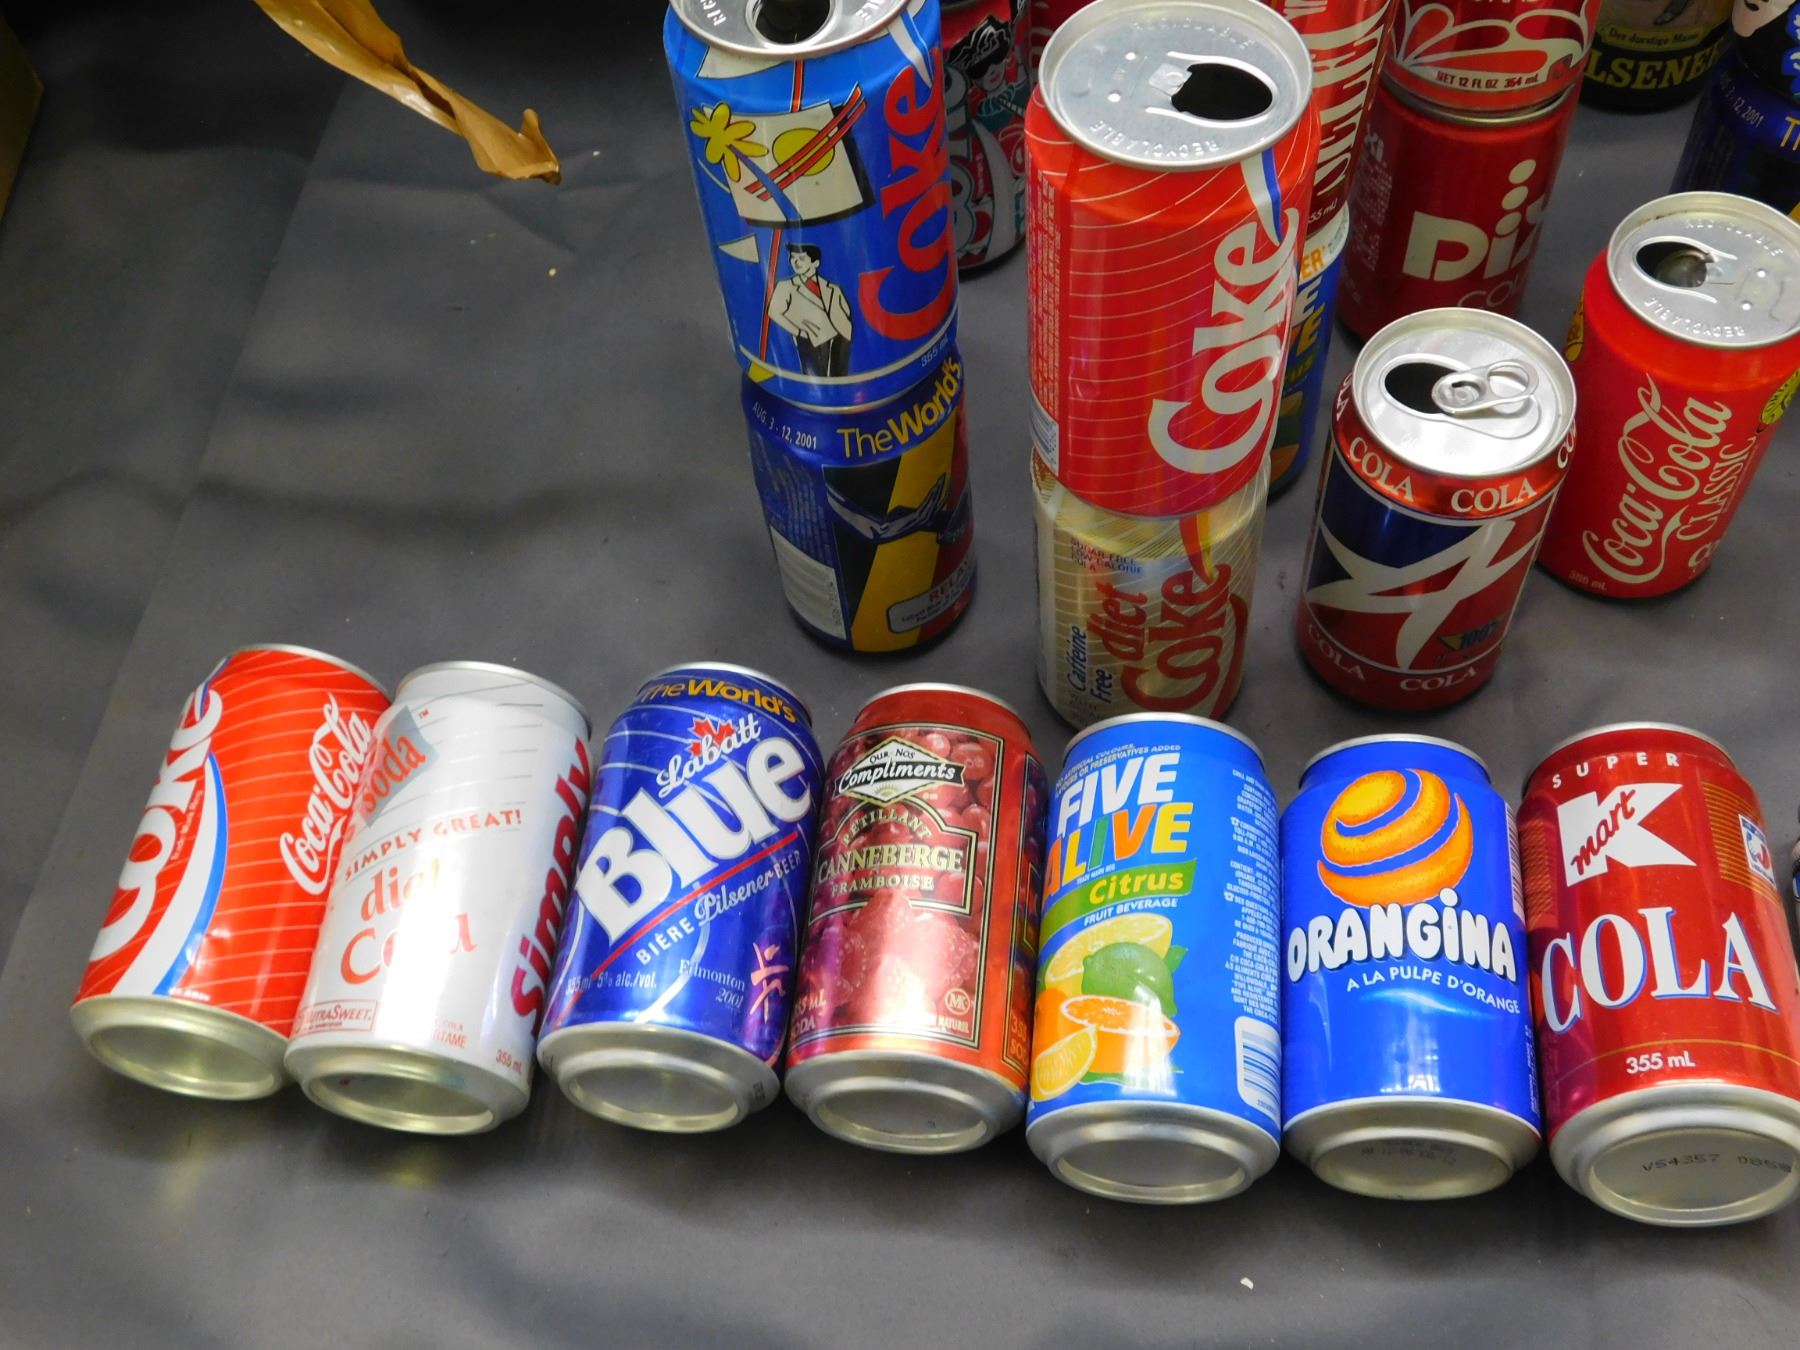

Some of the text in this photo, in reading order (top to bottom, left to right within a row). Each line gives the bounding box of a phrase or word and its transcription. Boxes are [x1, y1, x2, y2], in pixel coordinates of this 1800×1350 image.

[1458, 74, 1469, 87] 12
[1471, 79, 1482, 89] FL
[1485, 79, 1499, 89] OZ
[1148, 207, 1300, 474] Coke
[795, 431, 818, 451] 2001
[836, 427, 893, 459] The
[1349, 436, 1415, 503] COLA
[1450, 476, 1537, 513] COLA
[1582, 372, 1733, 584] Coca-Cola
[1676, 435, 1757, 542] CLASSIC
[1086, 580, 1148, 662] diet
[1120, 562, 1232, 713] Coke
[1308, 622, 1477, 691] COLA COLA
[1067, 625, 1088, 692] Caffeine
[1091, 668, 1113, 704] Free
[687, 678, 798, 724] World's
[656, 712, 762, 799] Labatt
[868, 750, 889, 765] OUR
[895, 747, 916, 759] NOS
[1151, 744, 1182, 753] ADDED
[1552, 751, 1680, 790] SUPER
[279, 692, 376, 896] Coca-Cola
[838, 756, 956, 794] Compliments
[1056, 752, 1181, 839] FIVE
[345, 808, 523, 881] SIMPLY GREAT!
[575, 736, 812, 948] Blue
[1043, 801, 1194, 898] ALIVE
[1570, 788, 1637, 877] mart
[818, 843, 964, 885] CANNEBERGE
[831, 873, 935, 898] FRAMBOISE
[1089, 871, 1184, 905] Citrus
[635, 849, 802, 966] BIÈRE Pilsener BEER
[1083, 897, 1179, 927] FRUIT BEVERAGE
[677, 958, 746, 993] Edmonton
[1362, 970, 1386, 988] LA
[1389, 965, 1442, 987] PULPE
[1447, 974, 1521, 1015] D'ORANGE
[1541, 906, 1780, 1035] COLA
[714, 987, 745, 1009] 2001
[1625, 1050, 1696, 1075] 355 mL
